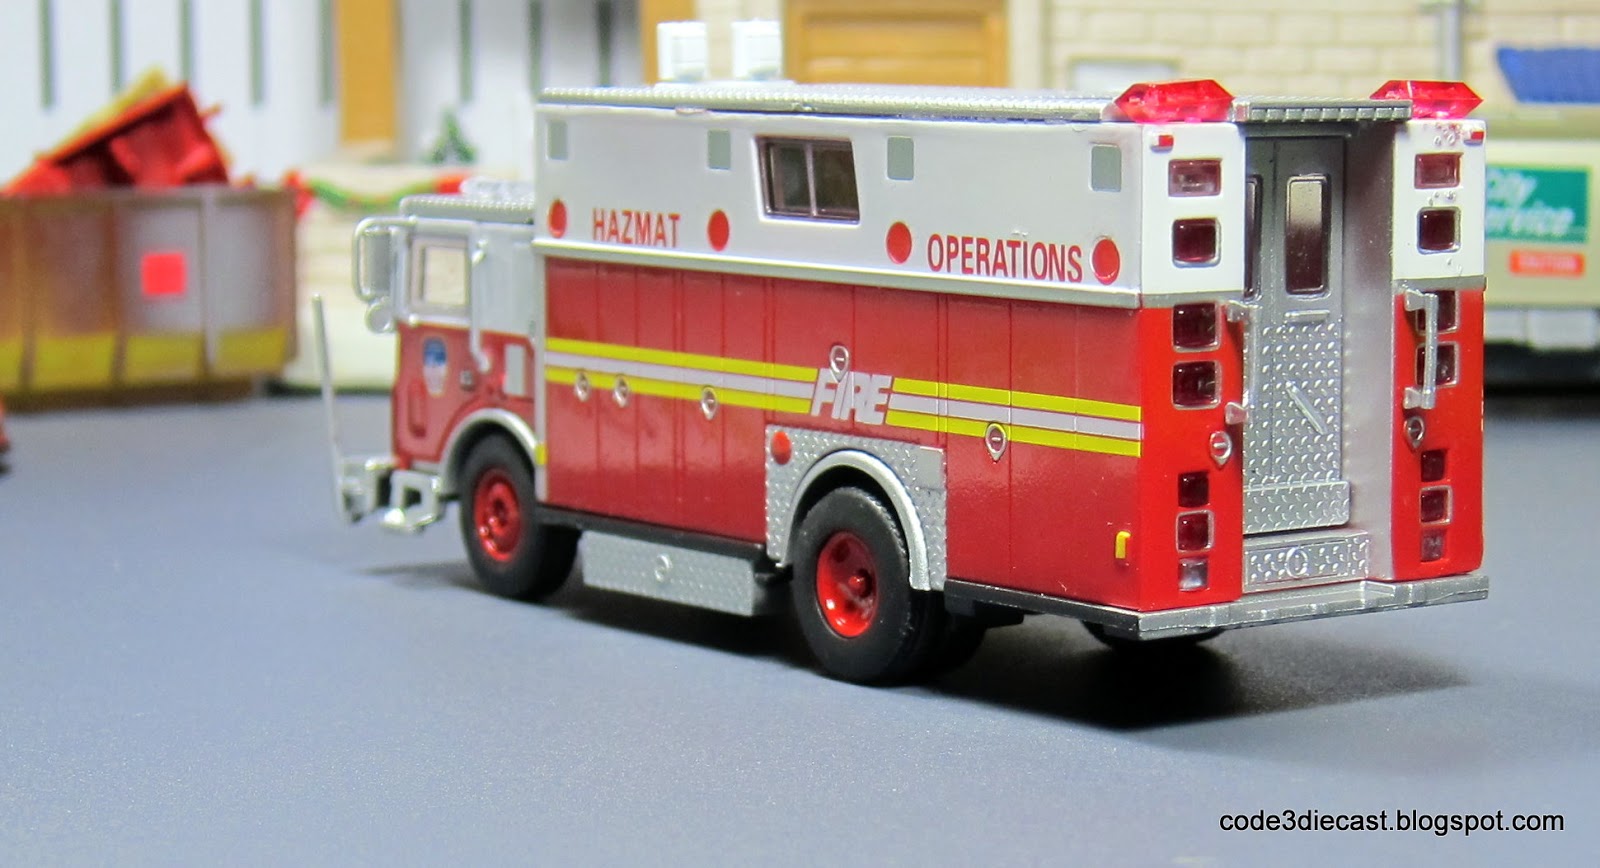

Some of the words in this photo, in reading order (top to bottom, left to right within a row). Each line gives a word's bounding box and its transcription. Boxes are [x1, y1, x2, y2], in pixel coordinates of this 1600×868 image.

[592, 208, 681, 248] HAZMAT
[927, 233, 1083, 283] OPERATIONS
[1484, 201, 1575, 235] ervice
[810, 367, 893, 425] FIRE
